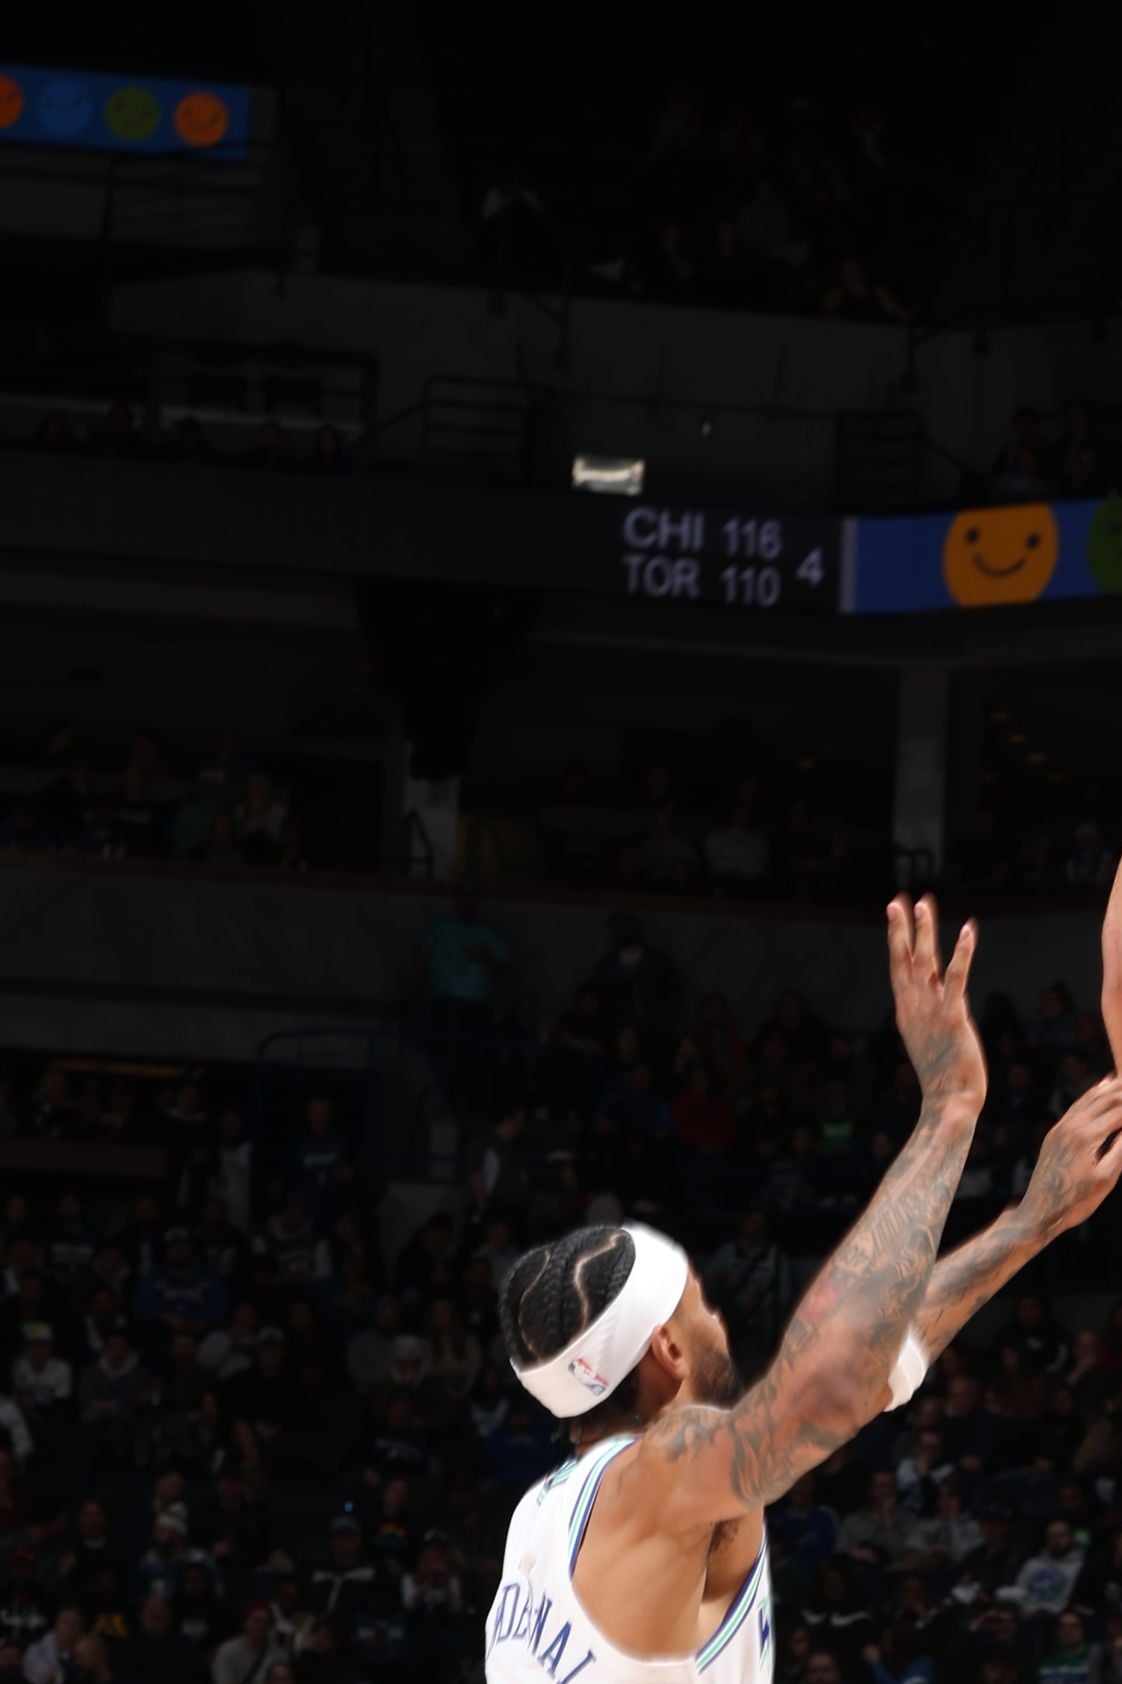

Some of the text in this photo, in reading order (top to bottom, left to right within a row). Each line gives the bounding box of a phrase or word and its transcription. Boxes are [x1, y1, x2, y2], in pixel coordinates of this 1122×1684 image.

[623, 507, 782, 561] CHI 116
[622, 548, 824, 608] TOR 110 4
